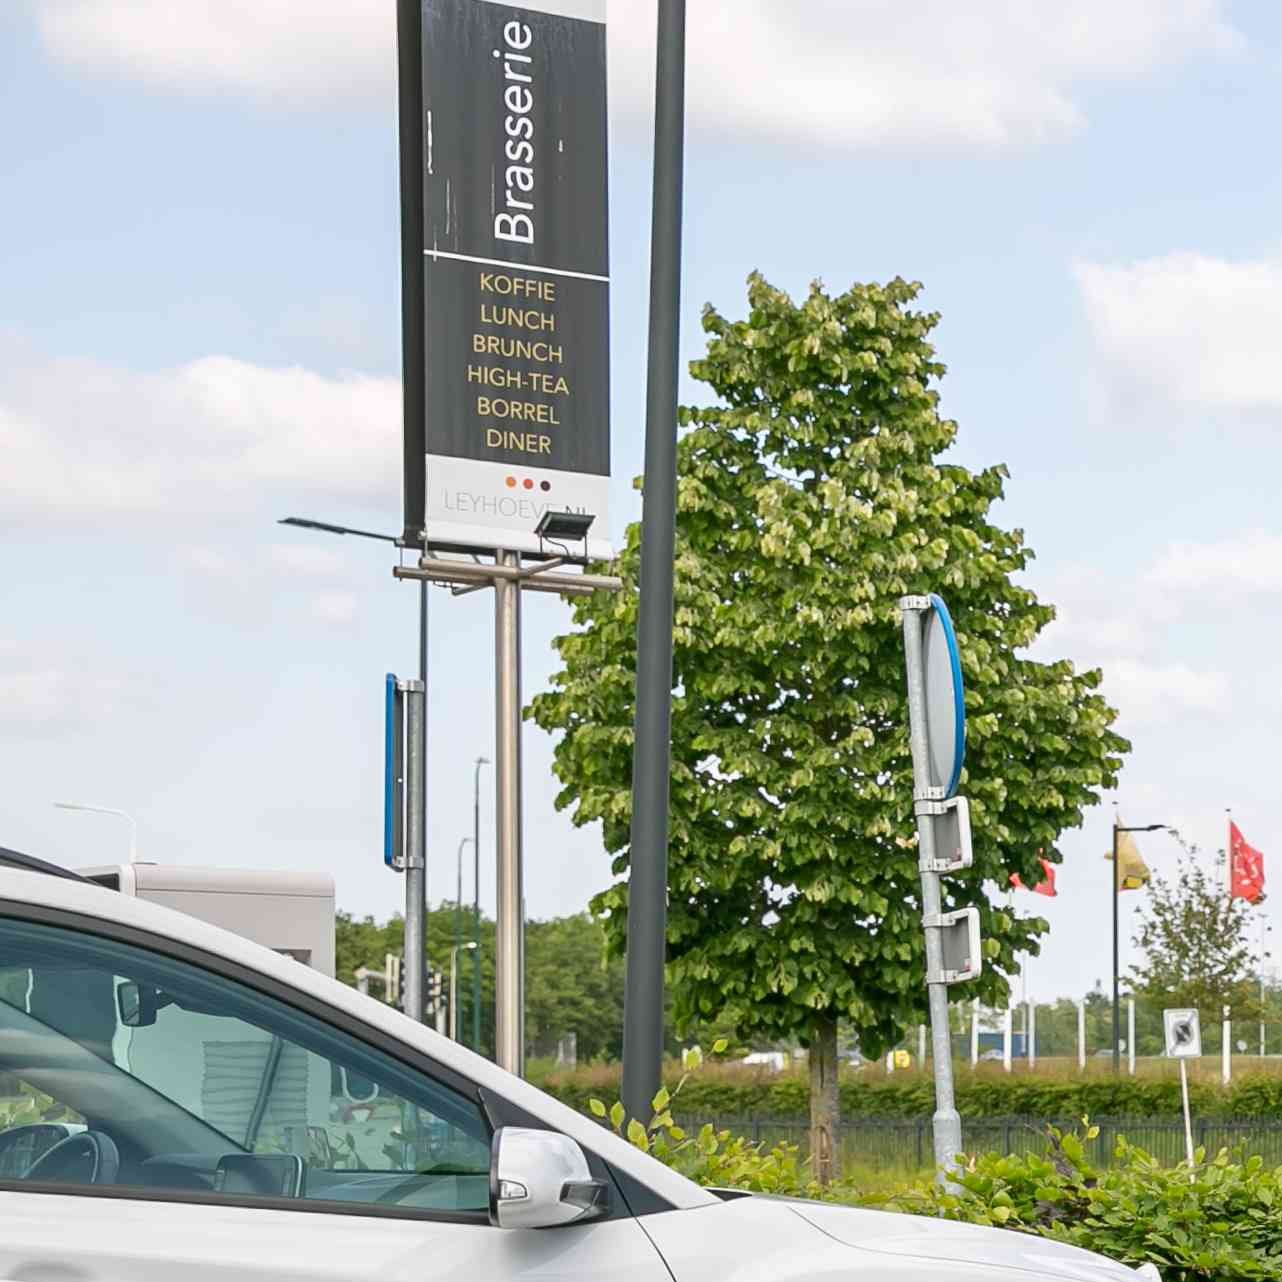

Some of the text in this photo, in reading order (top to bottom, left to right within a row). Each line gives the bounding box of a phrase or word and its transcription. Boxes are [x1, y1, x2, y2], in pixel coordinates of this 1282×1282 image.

[492, 20, 534, 244] Brasserie
[480, 272, 556, 302] KOFFIE
[481, 303, 555, 331] LUNCH
[473, 333, 563, 364] BRUNCH
[467, 364, 570, 395] HIGH-TEA
[477, 396, 560, 425] BORREL
[487, 428, 551, 455] DINER
